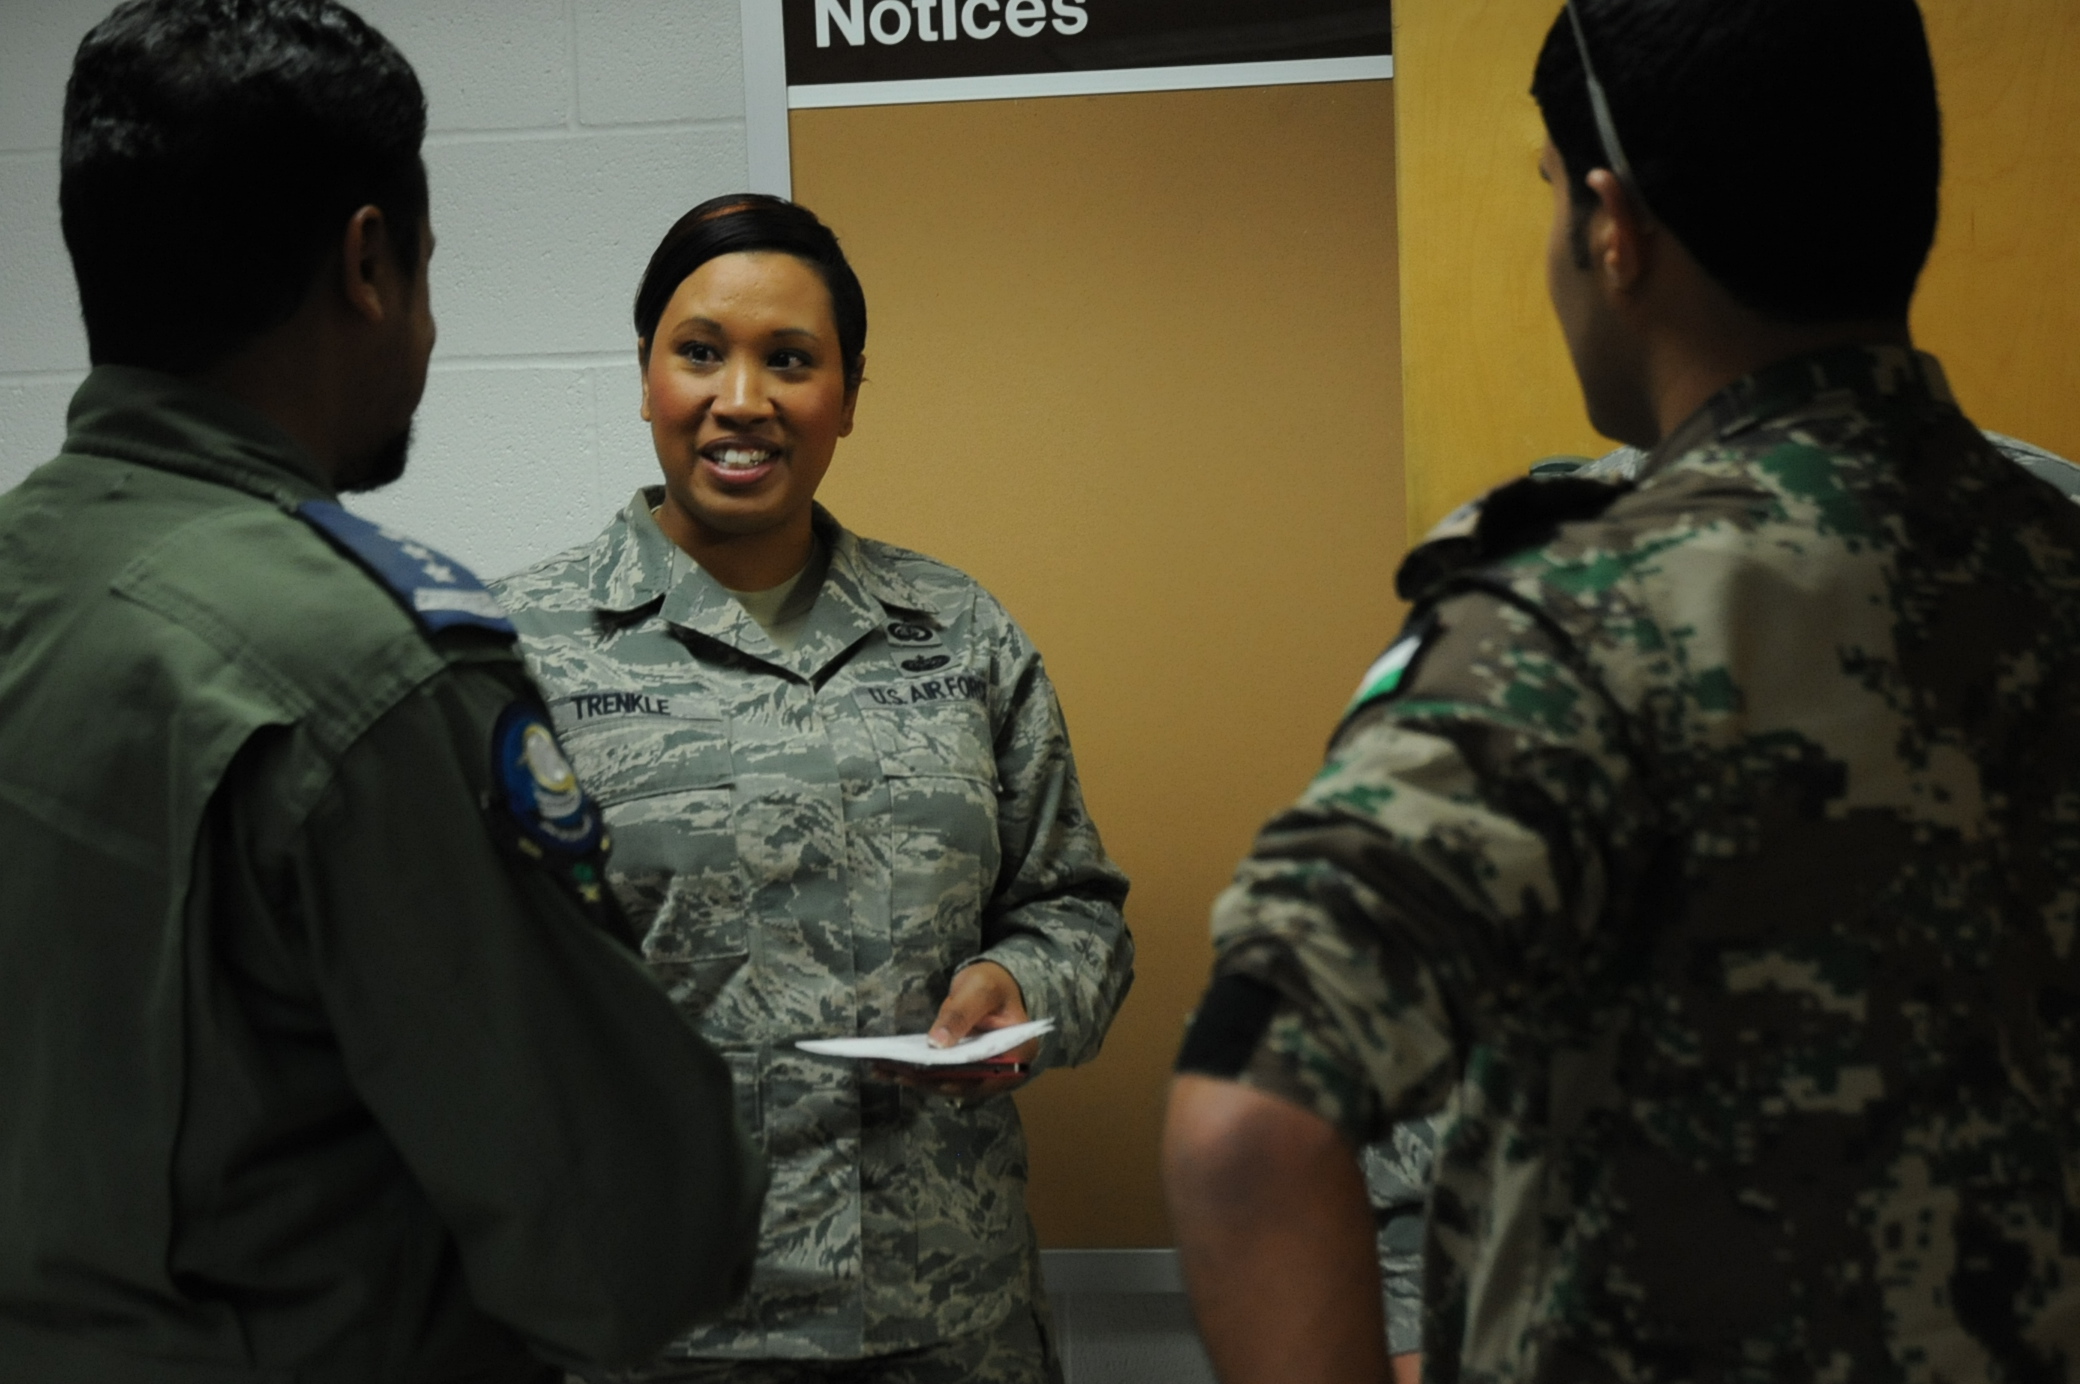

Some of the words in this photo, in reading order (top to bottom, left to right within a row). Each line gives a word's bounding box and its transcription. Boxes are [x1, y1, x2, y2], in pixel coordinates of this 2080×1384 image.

[814, 0, 1088, 48] Notices
[570, 693, 671, 720] TRENKLE
[868, 687, 908, 705] U.S.
[911, 681, 946, 703] AIR
